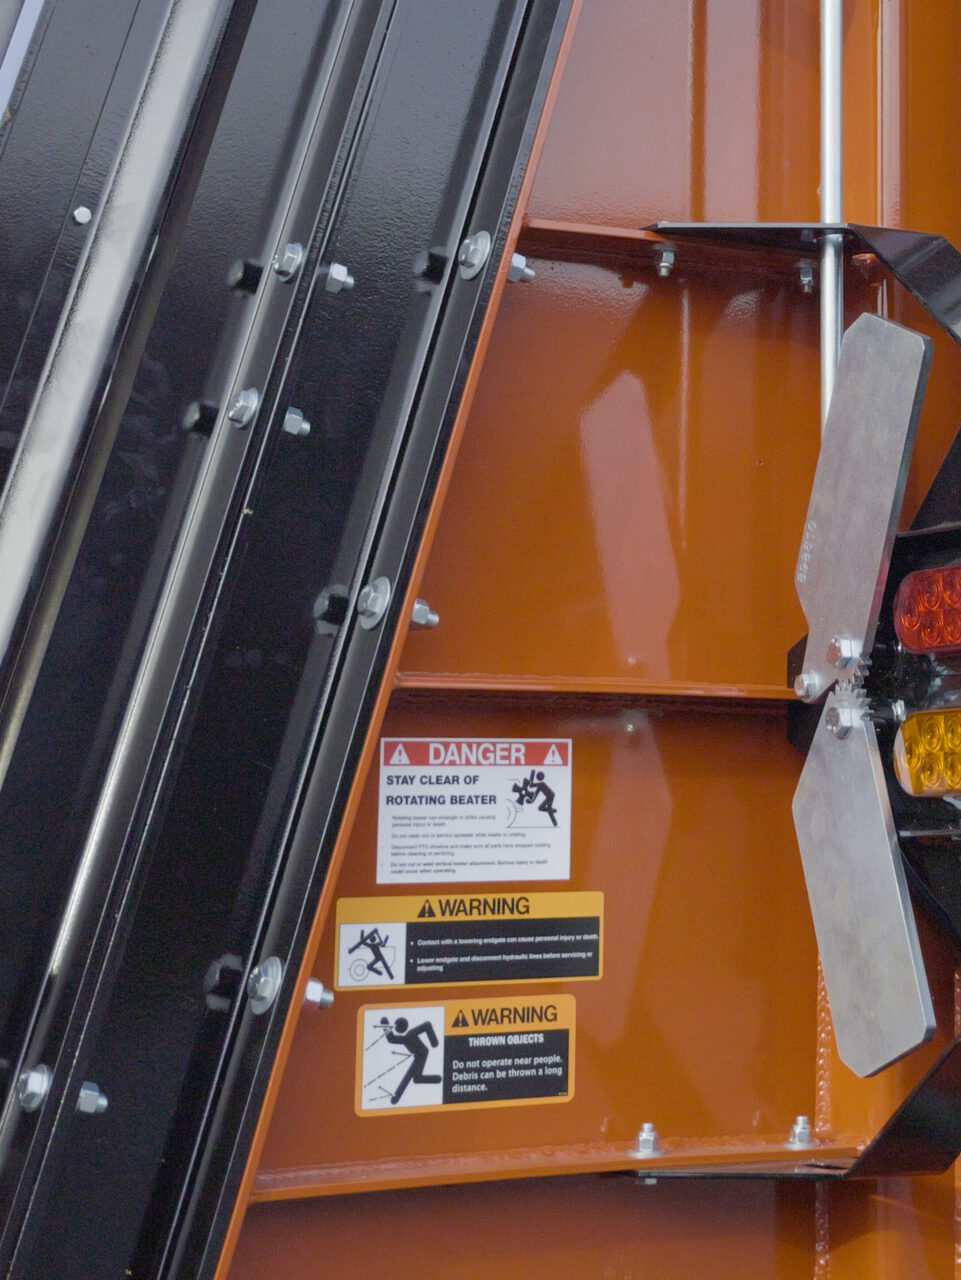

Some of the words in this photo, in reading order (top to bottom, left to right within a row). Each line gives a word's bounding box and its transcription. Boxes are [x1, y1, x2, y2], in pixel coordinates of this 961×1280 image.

[429, 743, 526, 765] DANGER
[386, 775, 416, 785] STAY
[419, 775, 460, 785] CLEAR
[463, 775, 480, 785] OF
[386, 795, 446, 806] ROTATING
[450, 795, 496, 805] BEATER
[438, 896, 530, 916] WARNING
[471, 1005, 558, 1026] WARNING
[468, 1035, 506, 1047] THROWN
[507, 1033, 544, 1045] OBJECTS
[452, 1060, 464, 1069] Do
[466, 1059, 480, 1068] not
[482, 1058, 513, 1070] operate
[514, 1057, 532, 1065] near
[534, 1054, 562, 1067] people.
[452, 1071, 478, 1081] Debris
[480, 1071, 494, 1079] can
[496, 1069, 506, 1078] be
[508, 1067, 536, 1077] thrown
[545, 1066, 562, 1076] long
[451, 1083, 488, 1093] distance.
